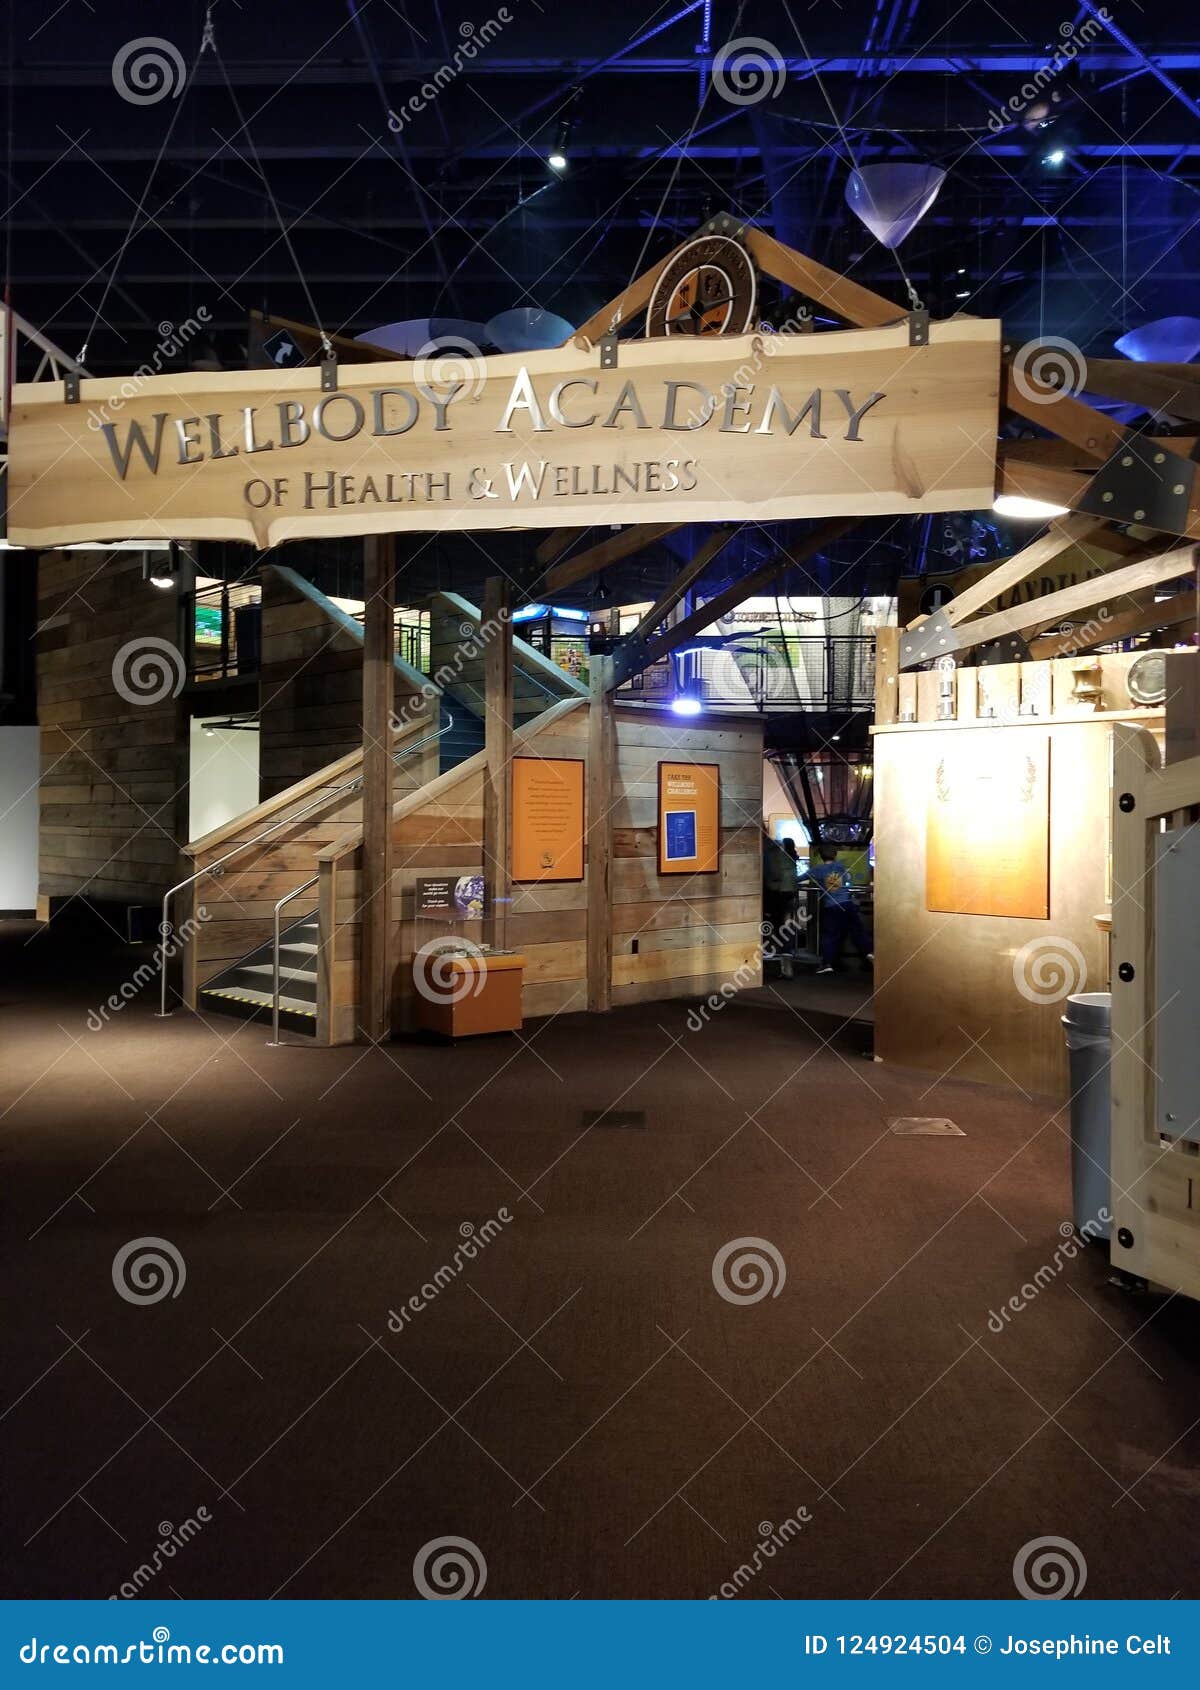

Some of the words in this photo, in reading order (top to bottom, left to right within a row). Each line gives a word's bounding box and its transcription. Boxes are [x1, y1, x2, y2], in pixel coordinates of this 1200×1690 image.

[101, 383, 463, 480] WELLBODY
[493, 366, 887, 441] ACADEMY
[244, 477, 289, 508] OF
[303, 470, 451, 509] HEALTH
[467, 467, 499, 500] &
[501, 459, 698, 502] WELLNESS
